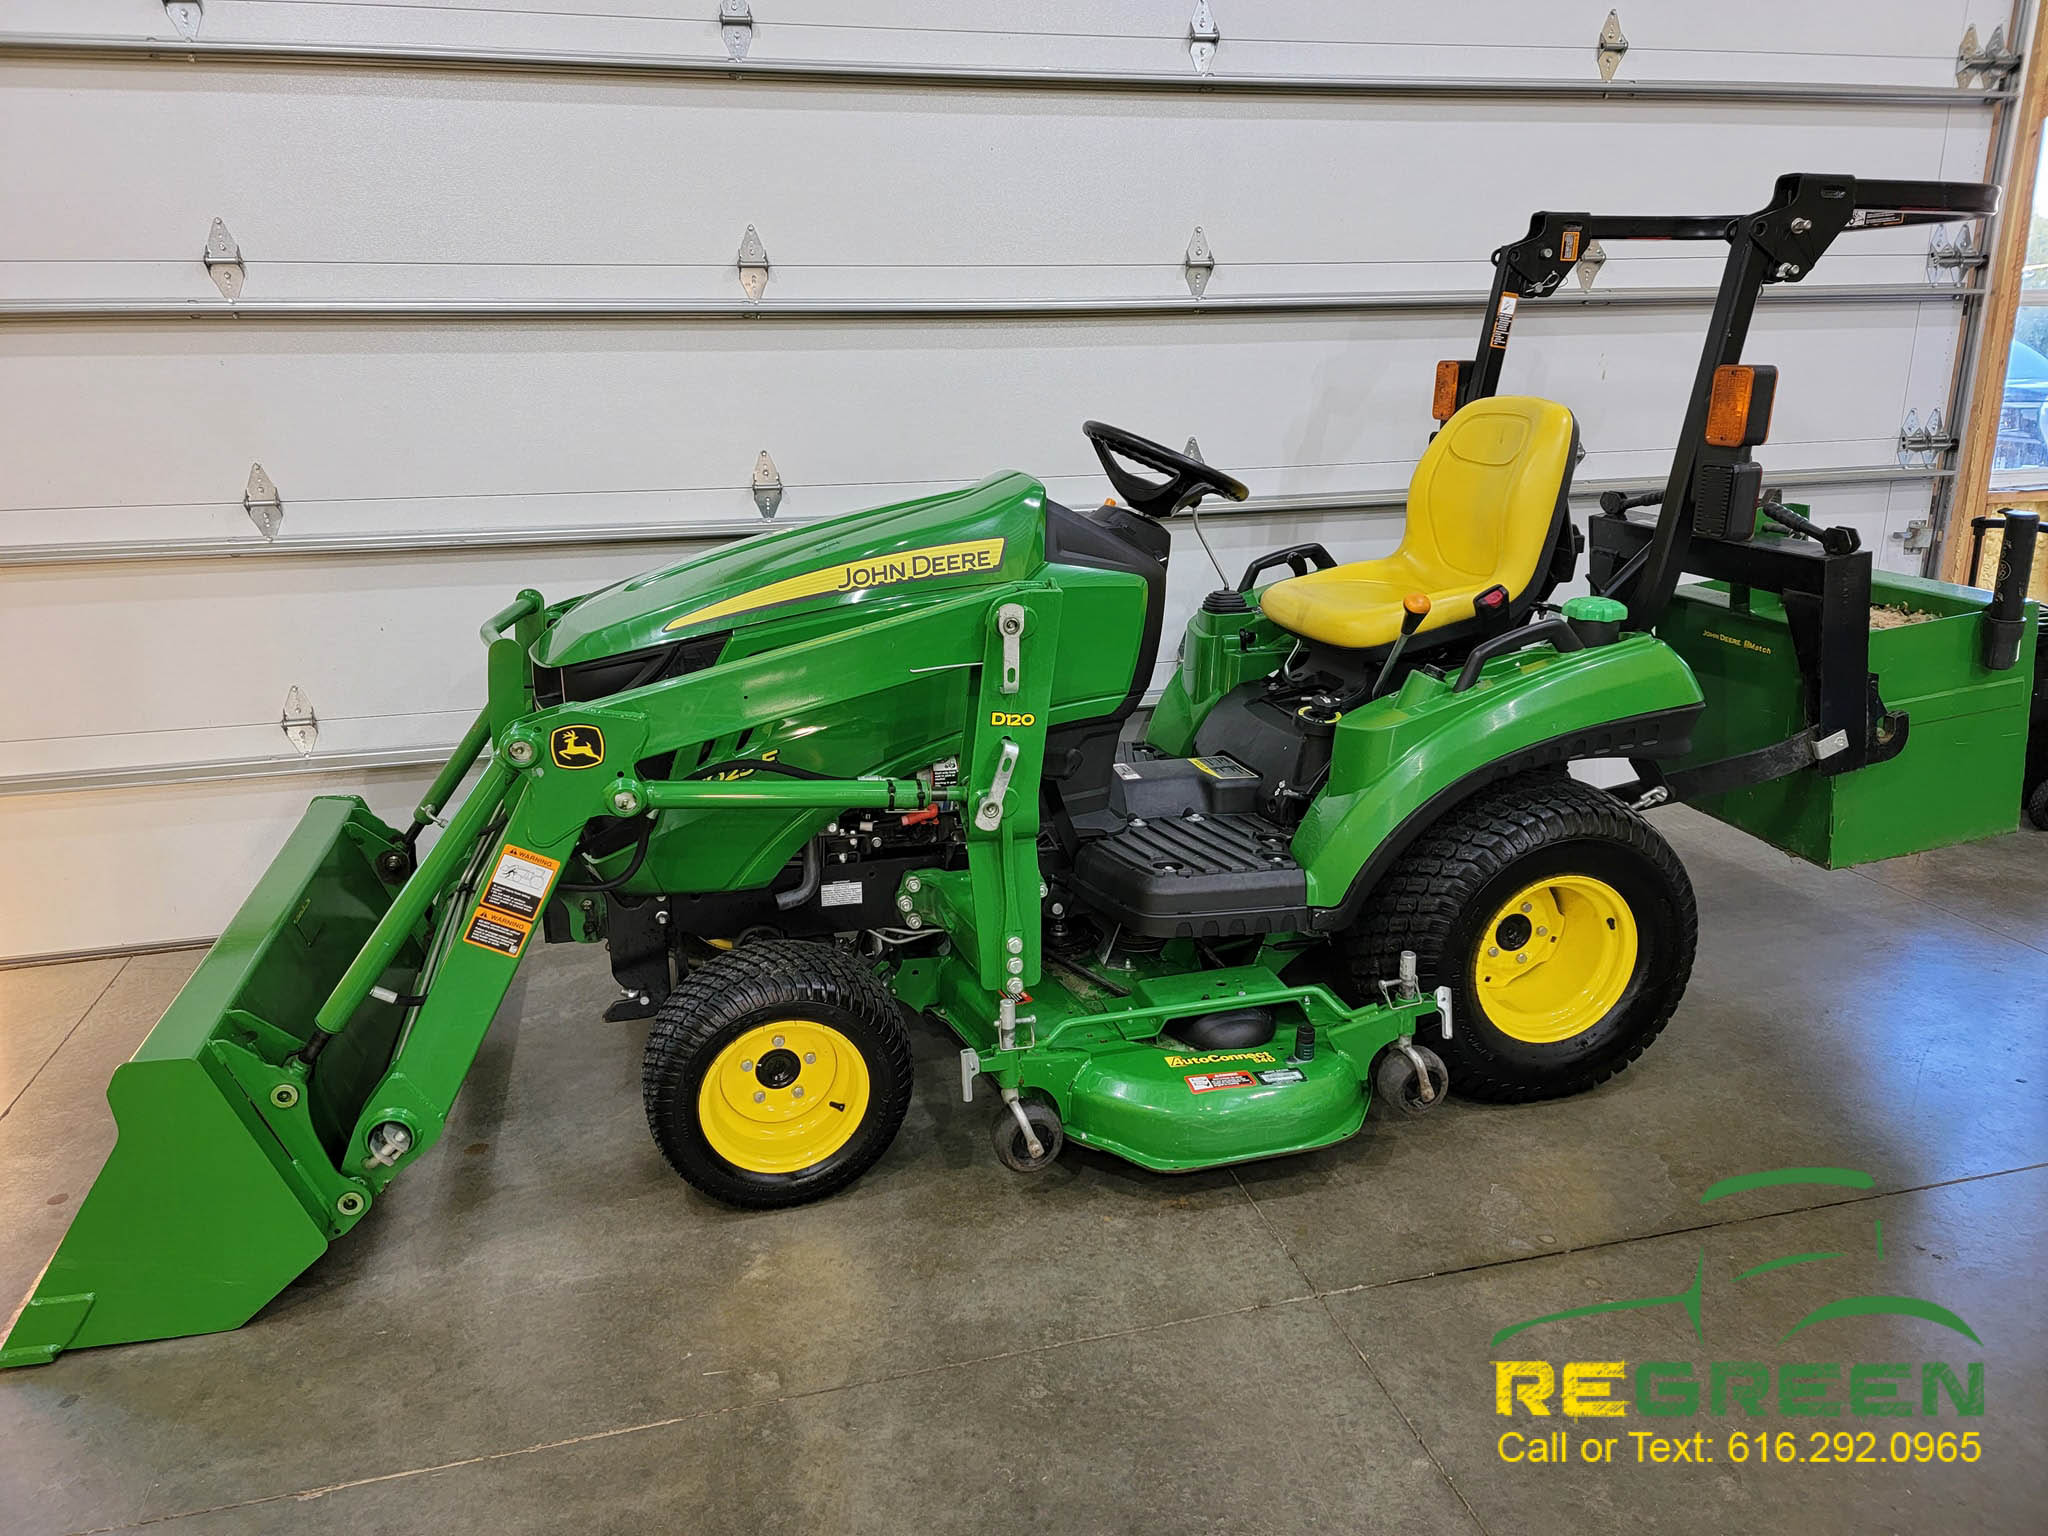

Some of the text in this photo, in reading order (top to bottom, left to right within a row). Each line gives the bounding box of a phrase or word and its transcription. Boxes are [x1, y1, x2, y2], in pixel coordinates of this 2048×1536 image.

[838, 550, 991, 589] JOHN DEERE
[1702, 630, 1719, 640] JOHN
[1720, 634, 1741, 646] DEERE
[991, 711, 1035, 726] D120
[519, 850, 552, 867] WARNING
[490, 914, 525, 930] WARNING
[1165, 1051, 1270, 1067] AutoConnect
